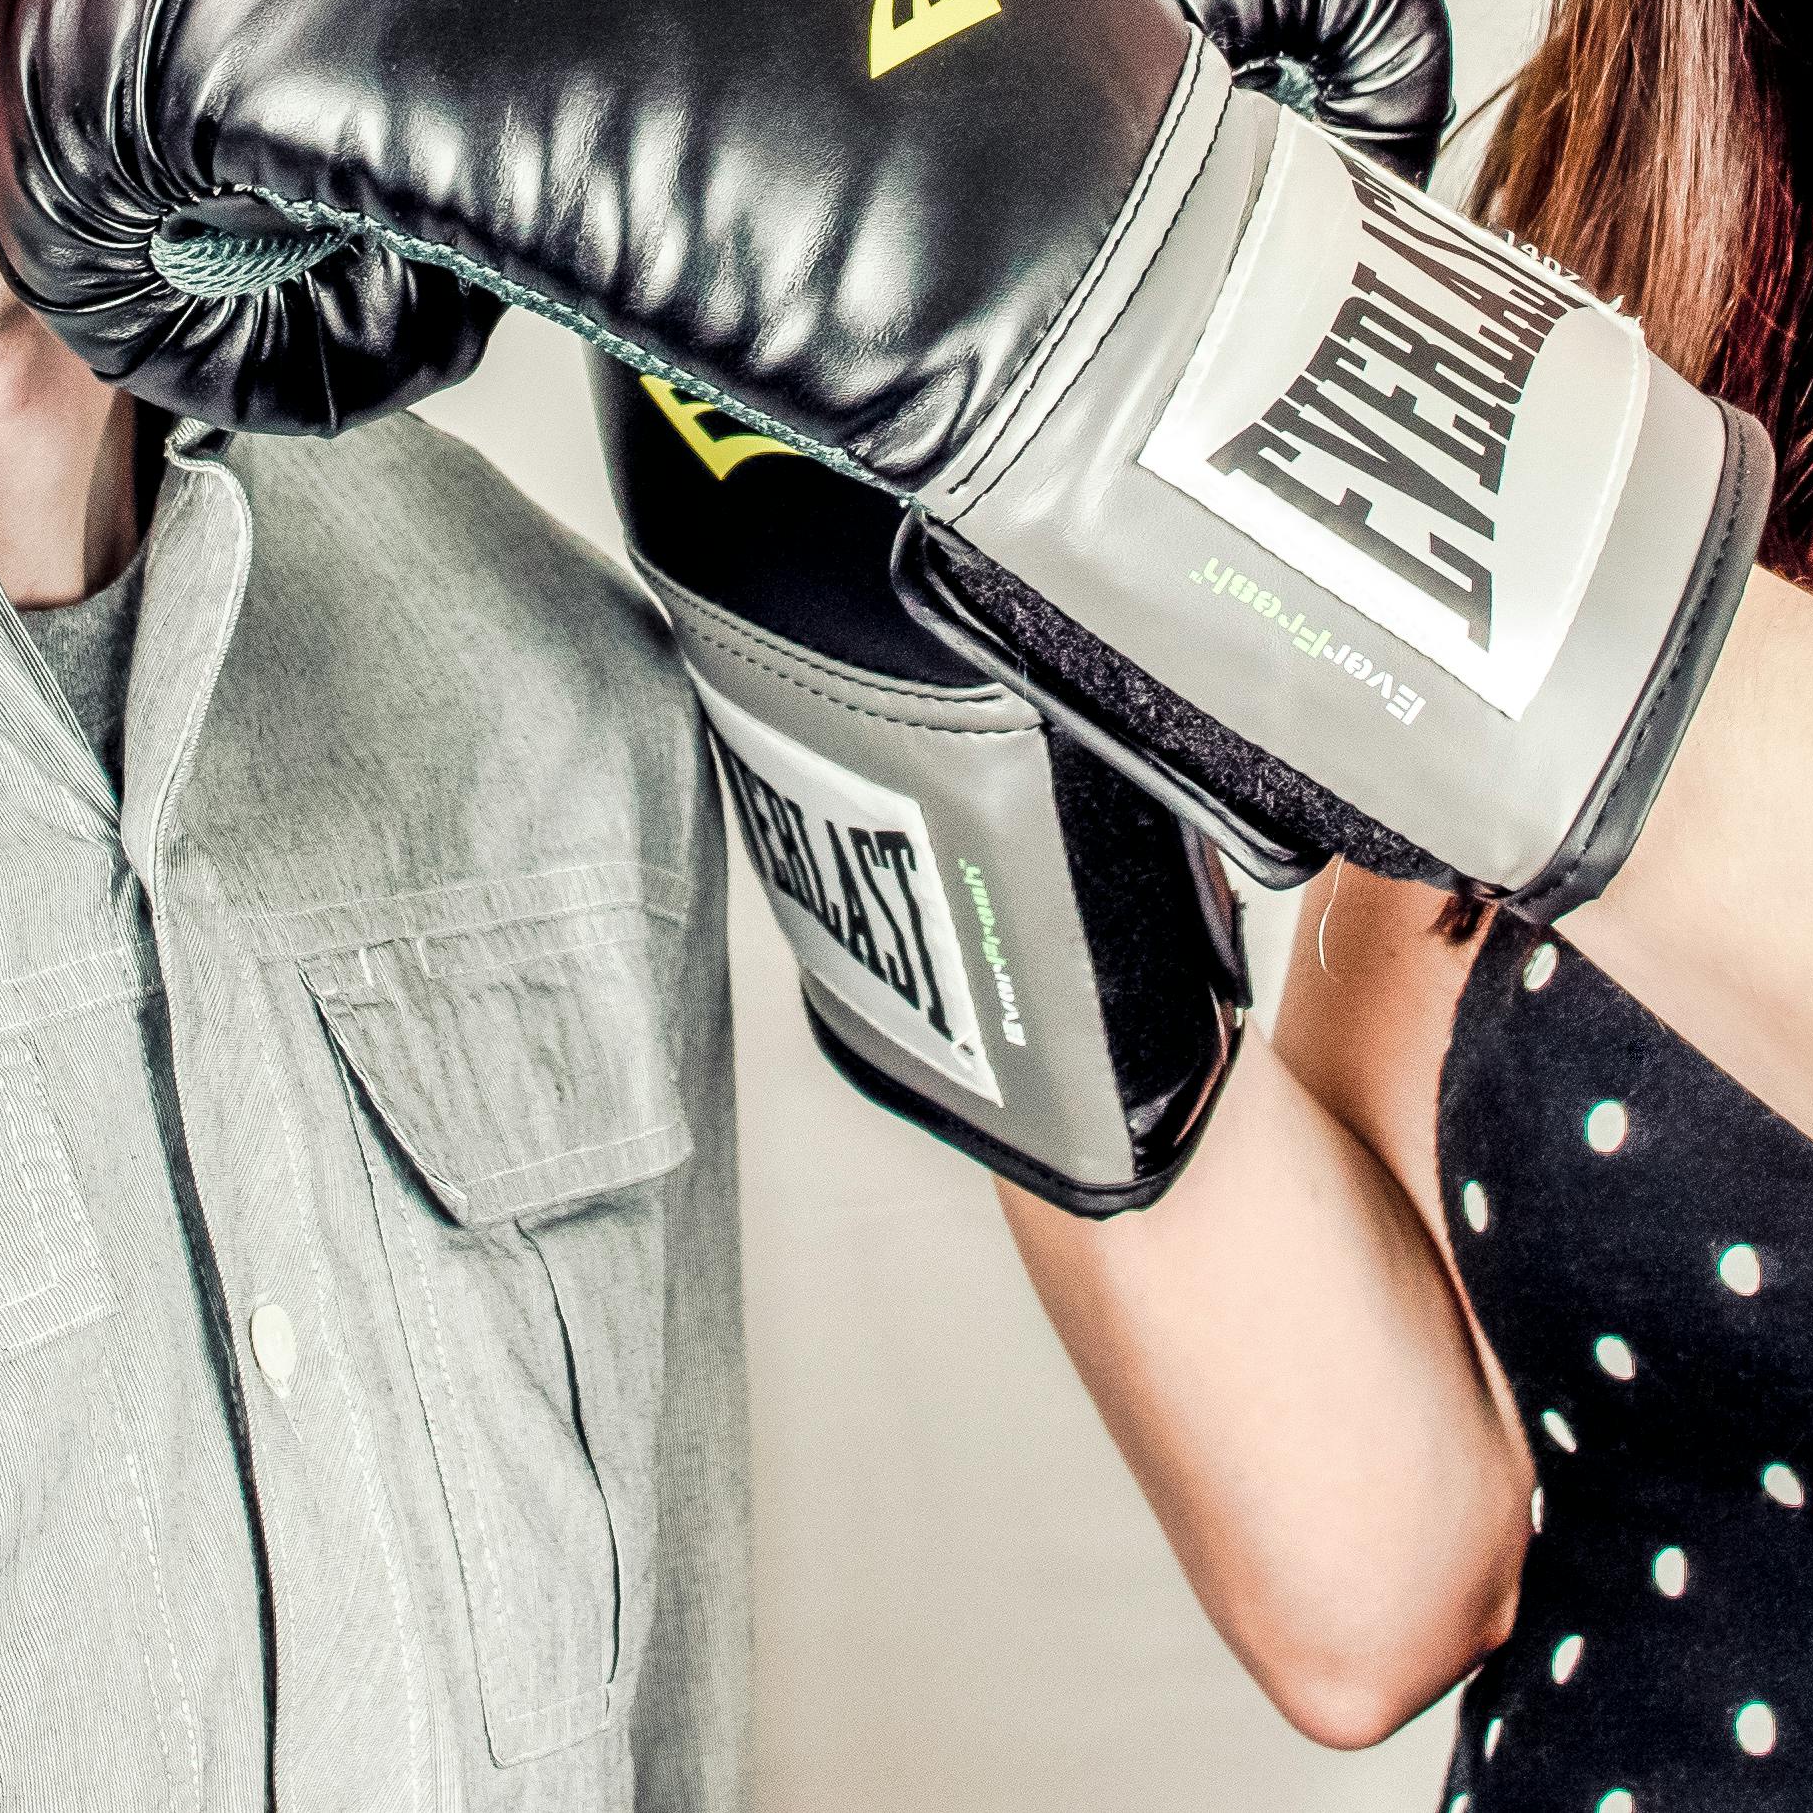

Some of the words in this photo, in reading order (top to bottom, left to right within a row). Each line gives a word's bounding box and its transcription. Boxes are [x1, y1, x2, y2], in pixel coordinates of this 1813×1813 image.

[1205, 141, 1588, 653] EVERLAST
[1201, 557, 1427, 726] EverFresh
[718, 743, 954, 1042] ERLAST
